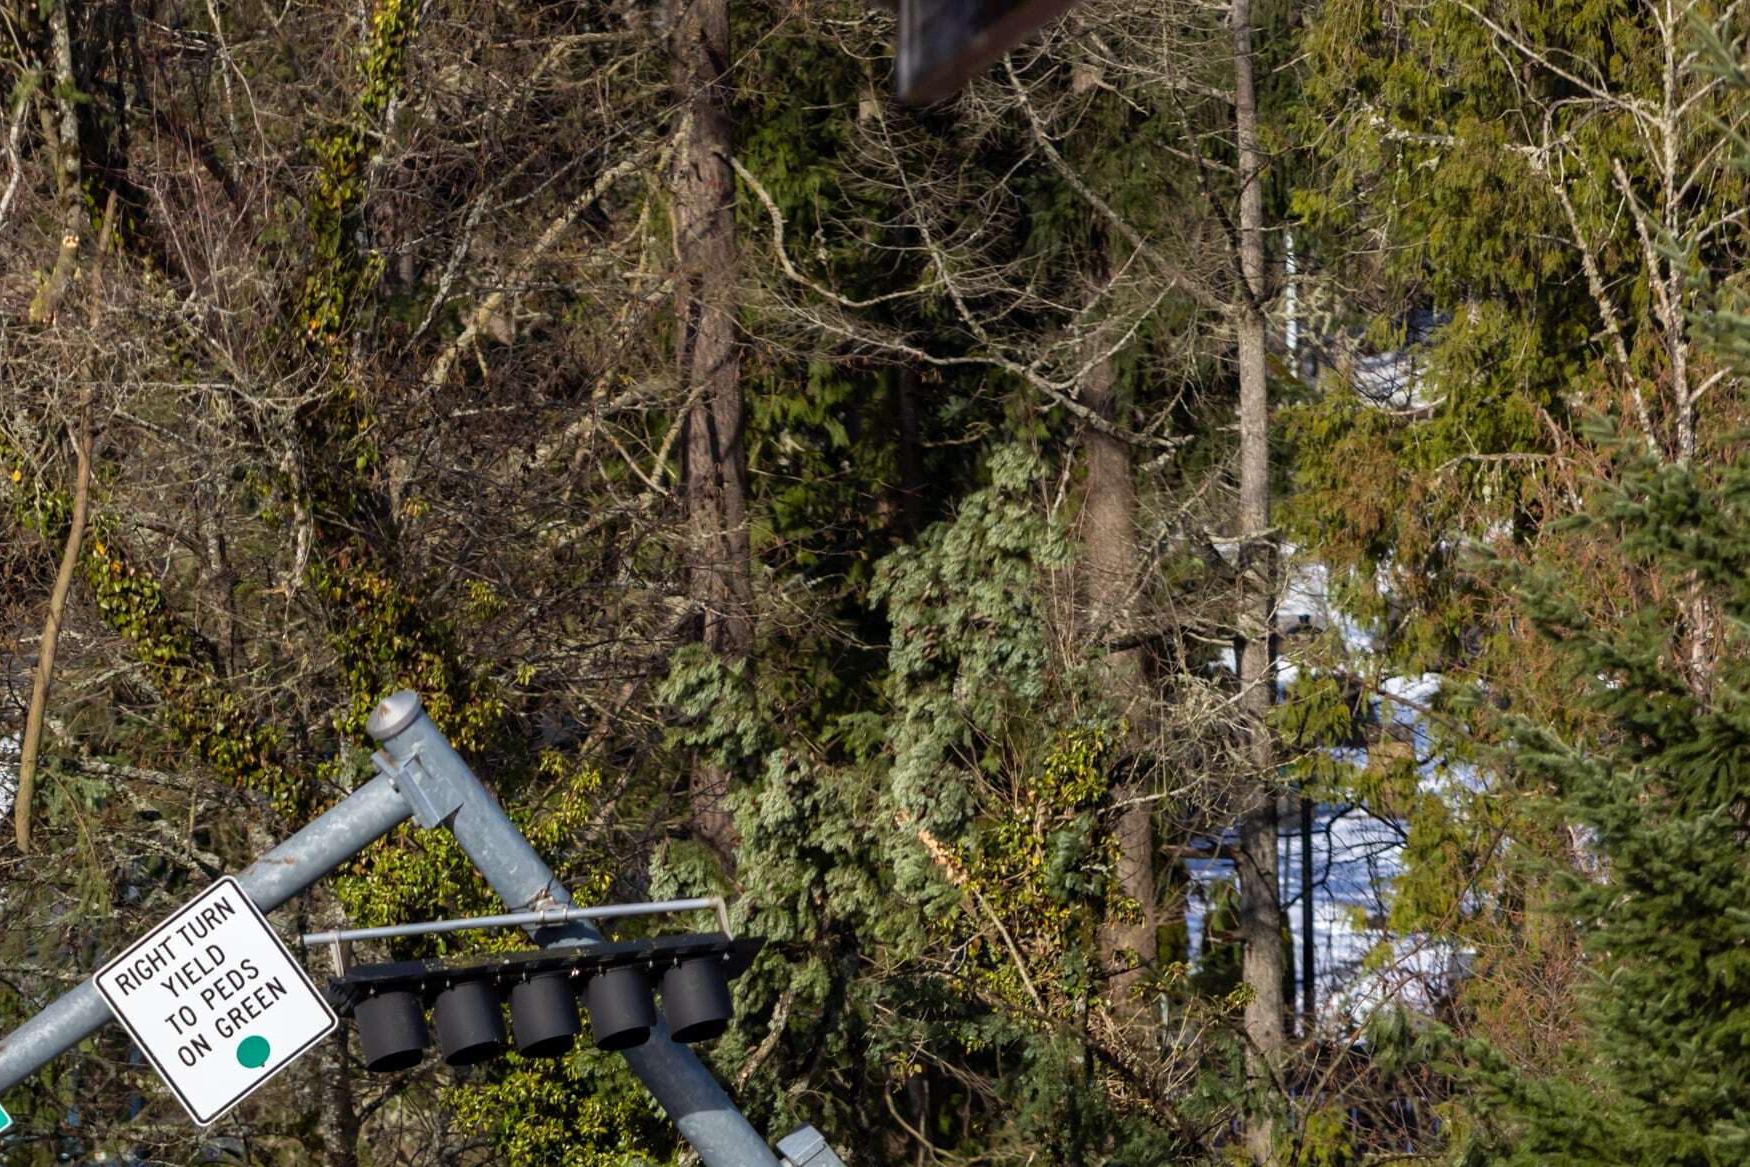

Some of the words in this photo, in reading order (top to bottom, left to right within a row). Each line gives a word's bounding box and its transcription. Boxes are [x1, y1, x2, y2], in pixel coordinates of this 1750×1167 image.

[115, 936, 176, 996] RIGHT
[176, 896, 236, 947] TURN
[161, 944, 226, 998] YIELD
[165, 1005, 197, 1035] TO
[200, 958, 259, 1011] PEDS
[177, 1033, 212, 1067] ON
[215, 976, 288, 1038] GREEN
